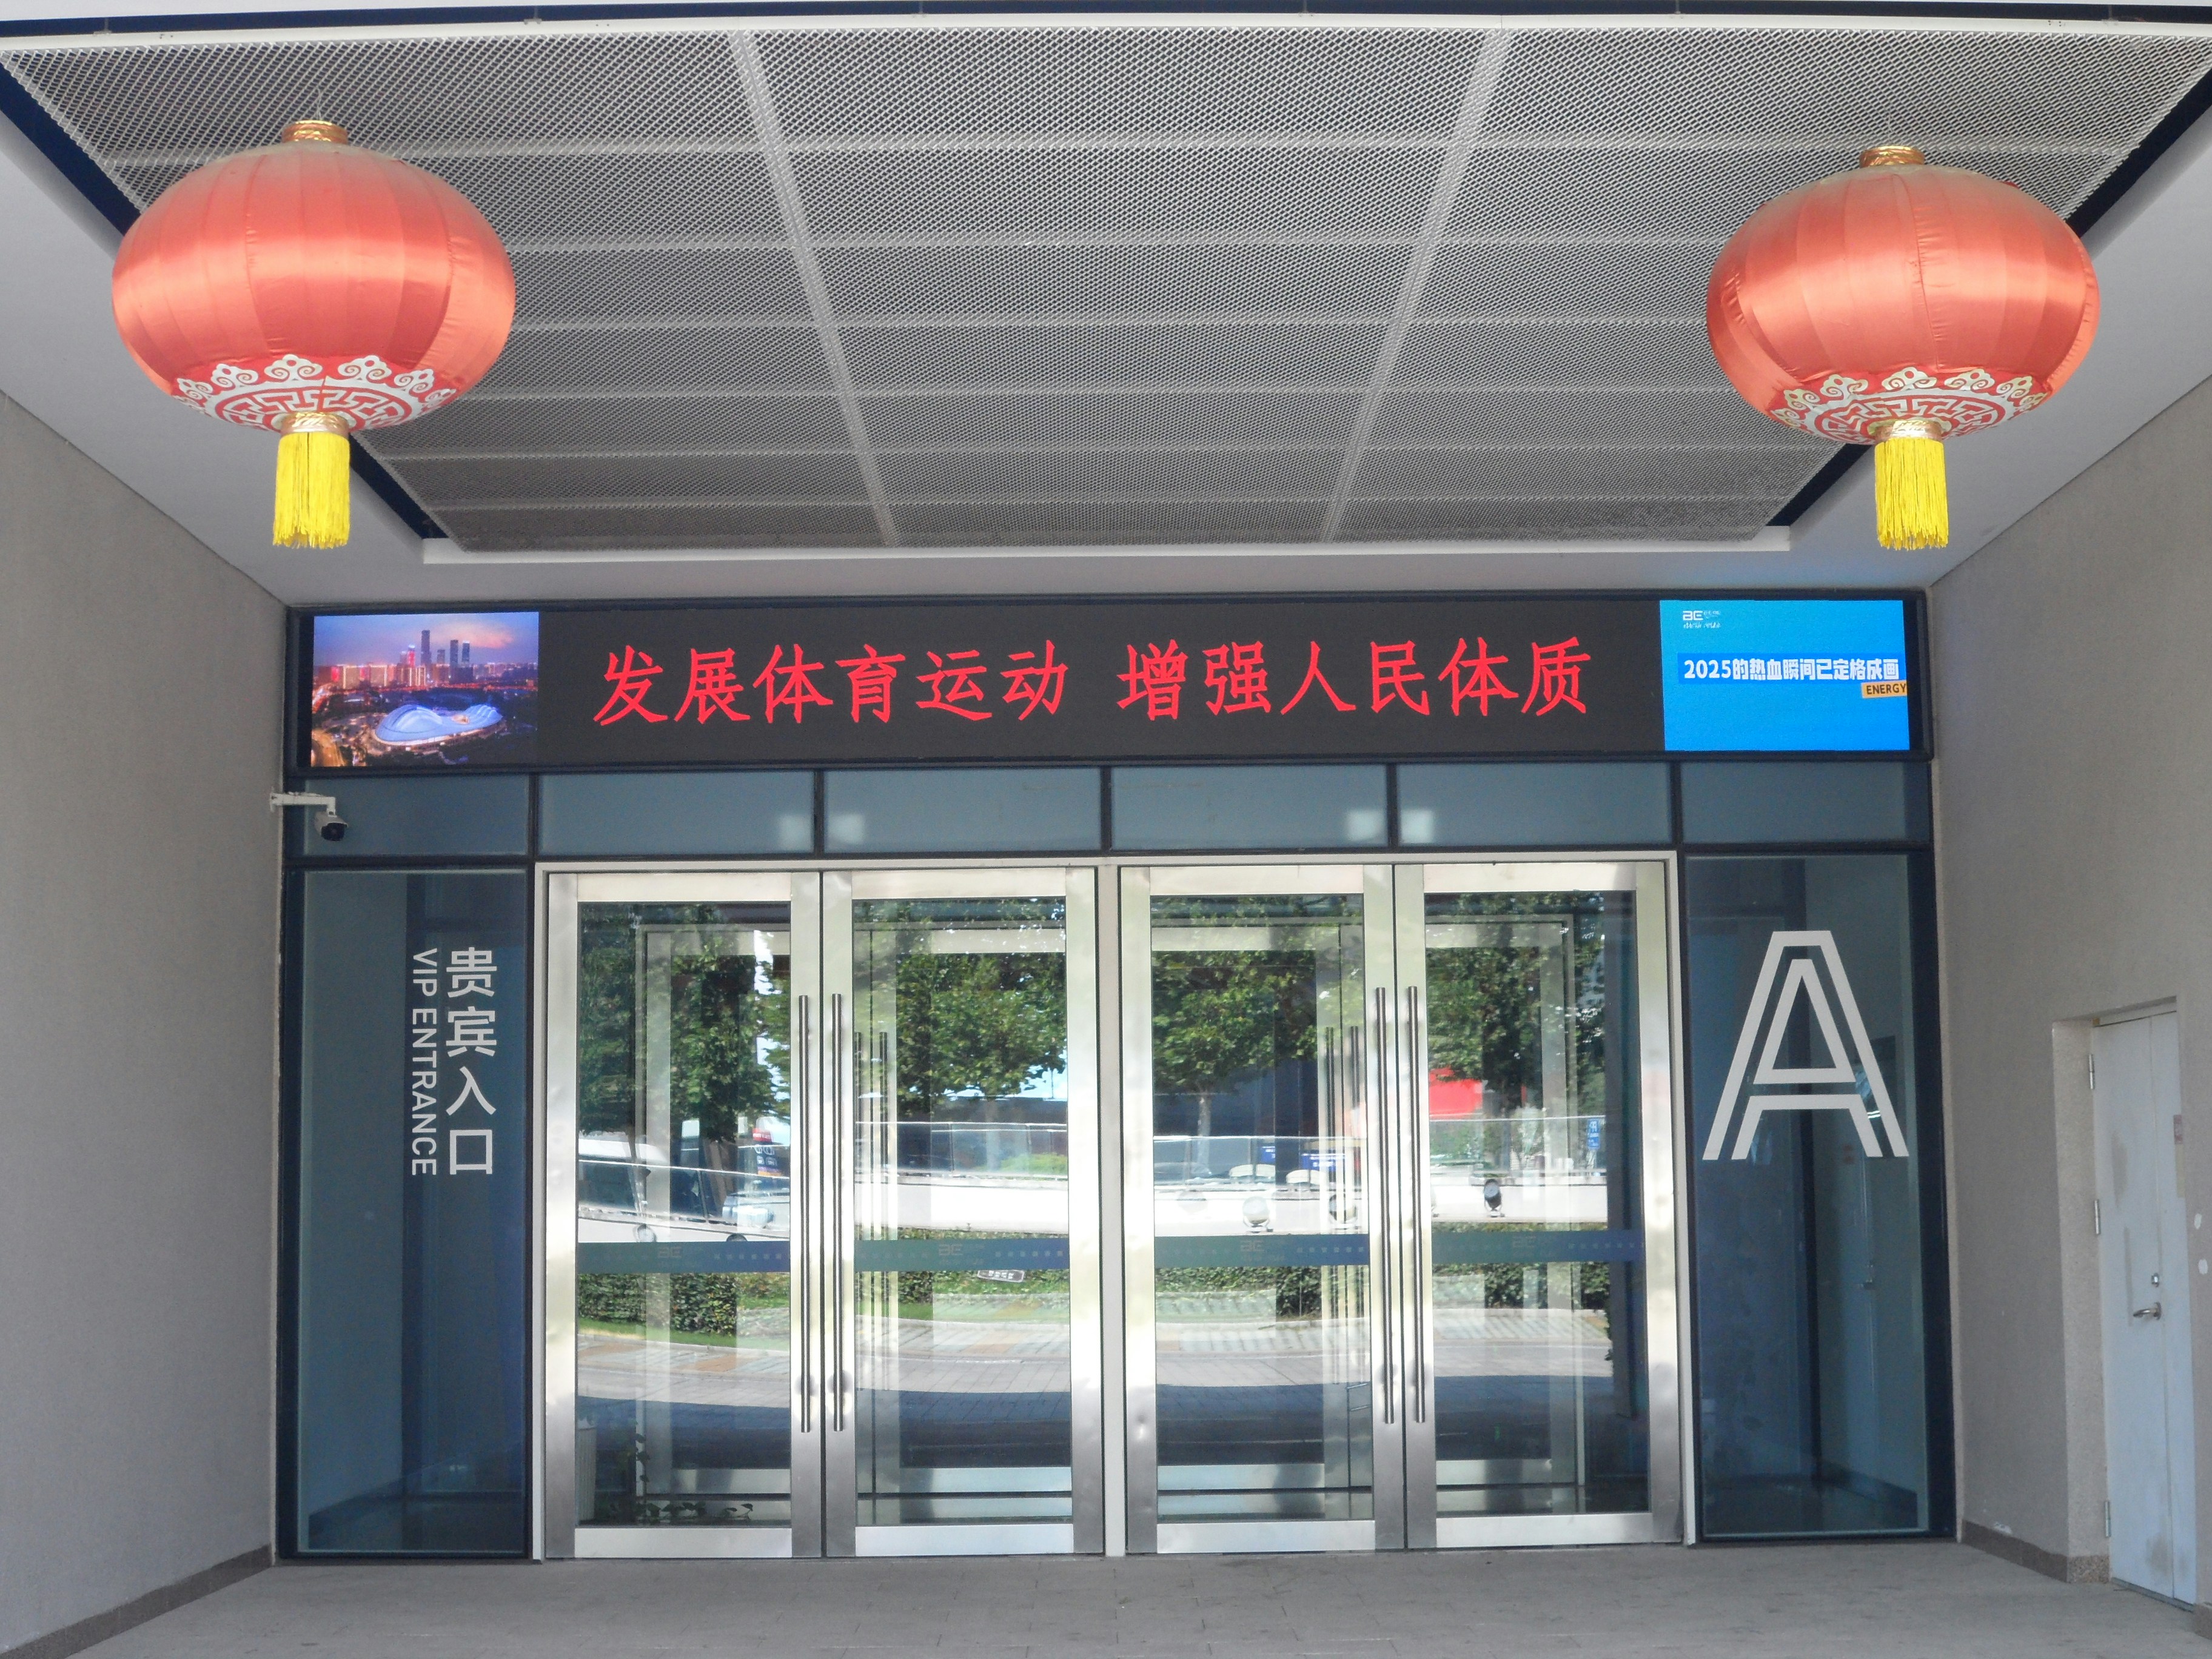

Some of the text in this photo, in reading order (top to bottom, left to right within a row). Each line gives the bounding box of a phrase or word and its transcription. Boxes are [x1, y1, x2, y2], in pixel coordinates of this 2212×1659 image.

[593, 637, 1591, 726] 发展体育运动 增强人民体质
[1684, 658, 1899, 680] 2025的热血瞬间已定格成画
[1866, 683, 1907, 695] ENERGY
[411, 947, 437, 1176] VIP ENTRANCE
[446, 946, 497, 1175] 贵宾入口
[1702, 930, 1909, 1161] A
